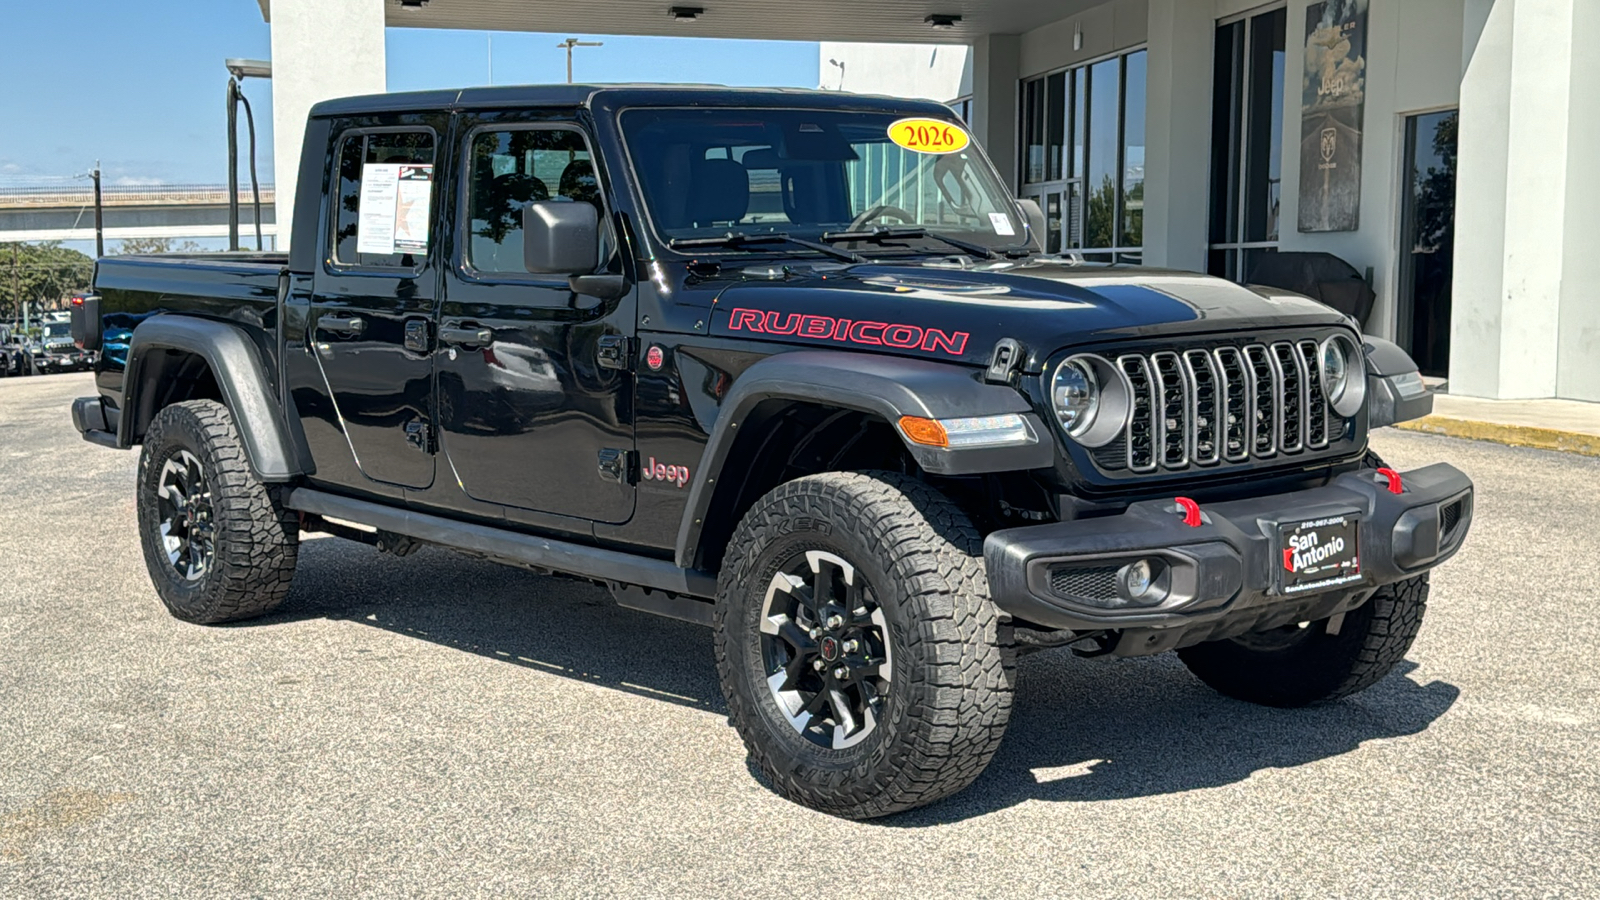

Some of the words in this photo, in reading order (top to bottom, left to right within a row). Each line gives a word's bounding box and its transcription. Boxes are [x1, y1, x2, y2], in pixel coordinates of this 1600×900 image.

[1317, 76, 1344, 97] Jeep
[904, 125, 954, 147] 2026
[728, 307, 970, 356] RUBICON
[642, 457, 690, 488] Jeep
[1289, 531, 1318, 553] San
[1293, 536, 1344, 572] Antonio
